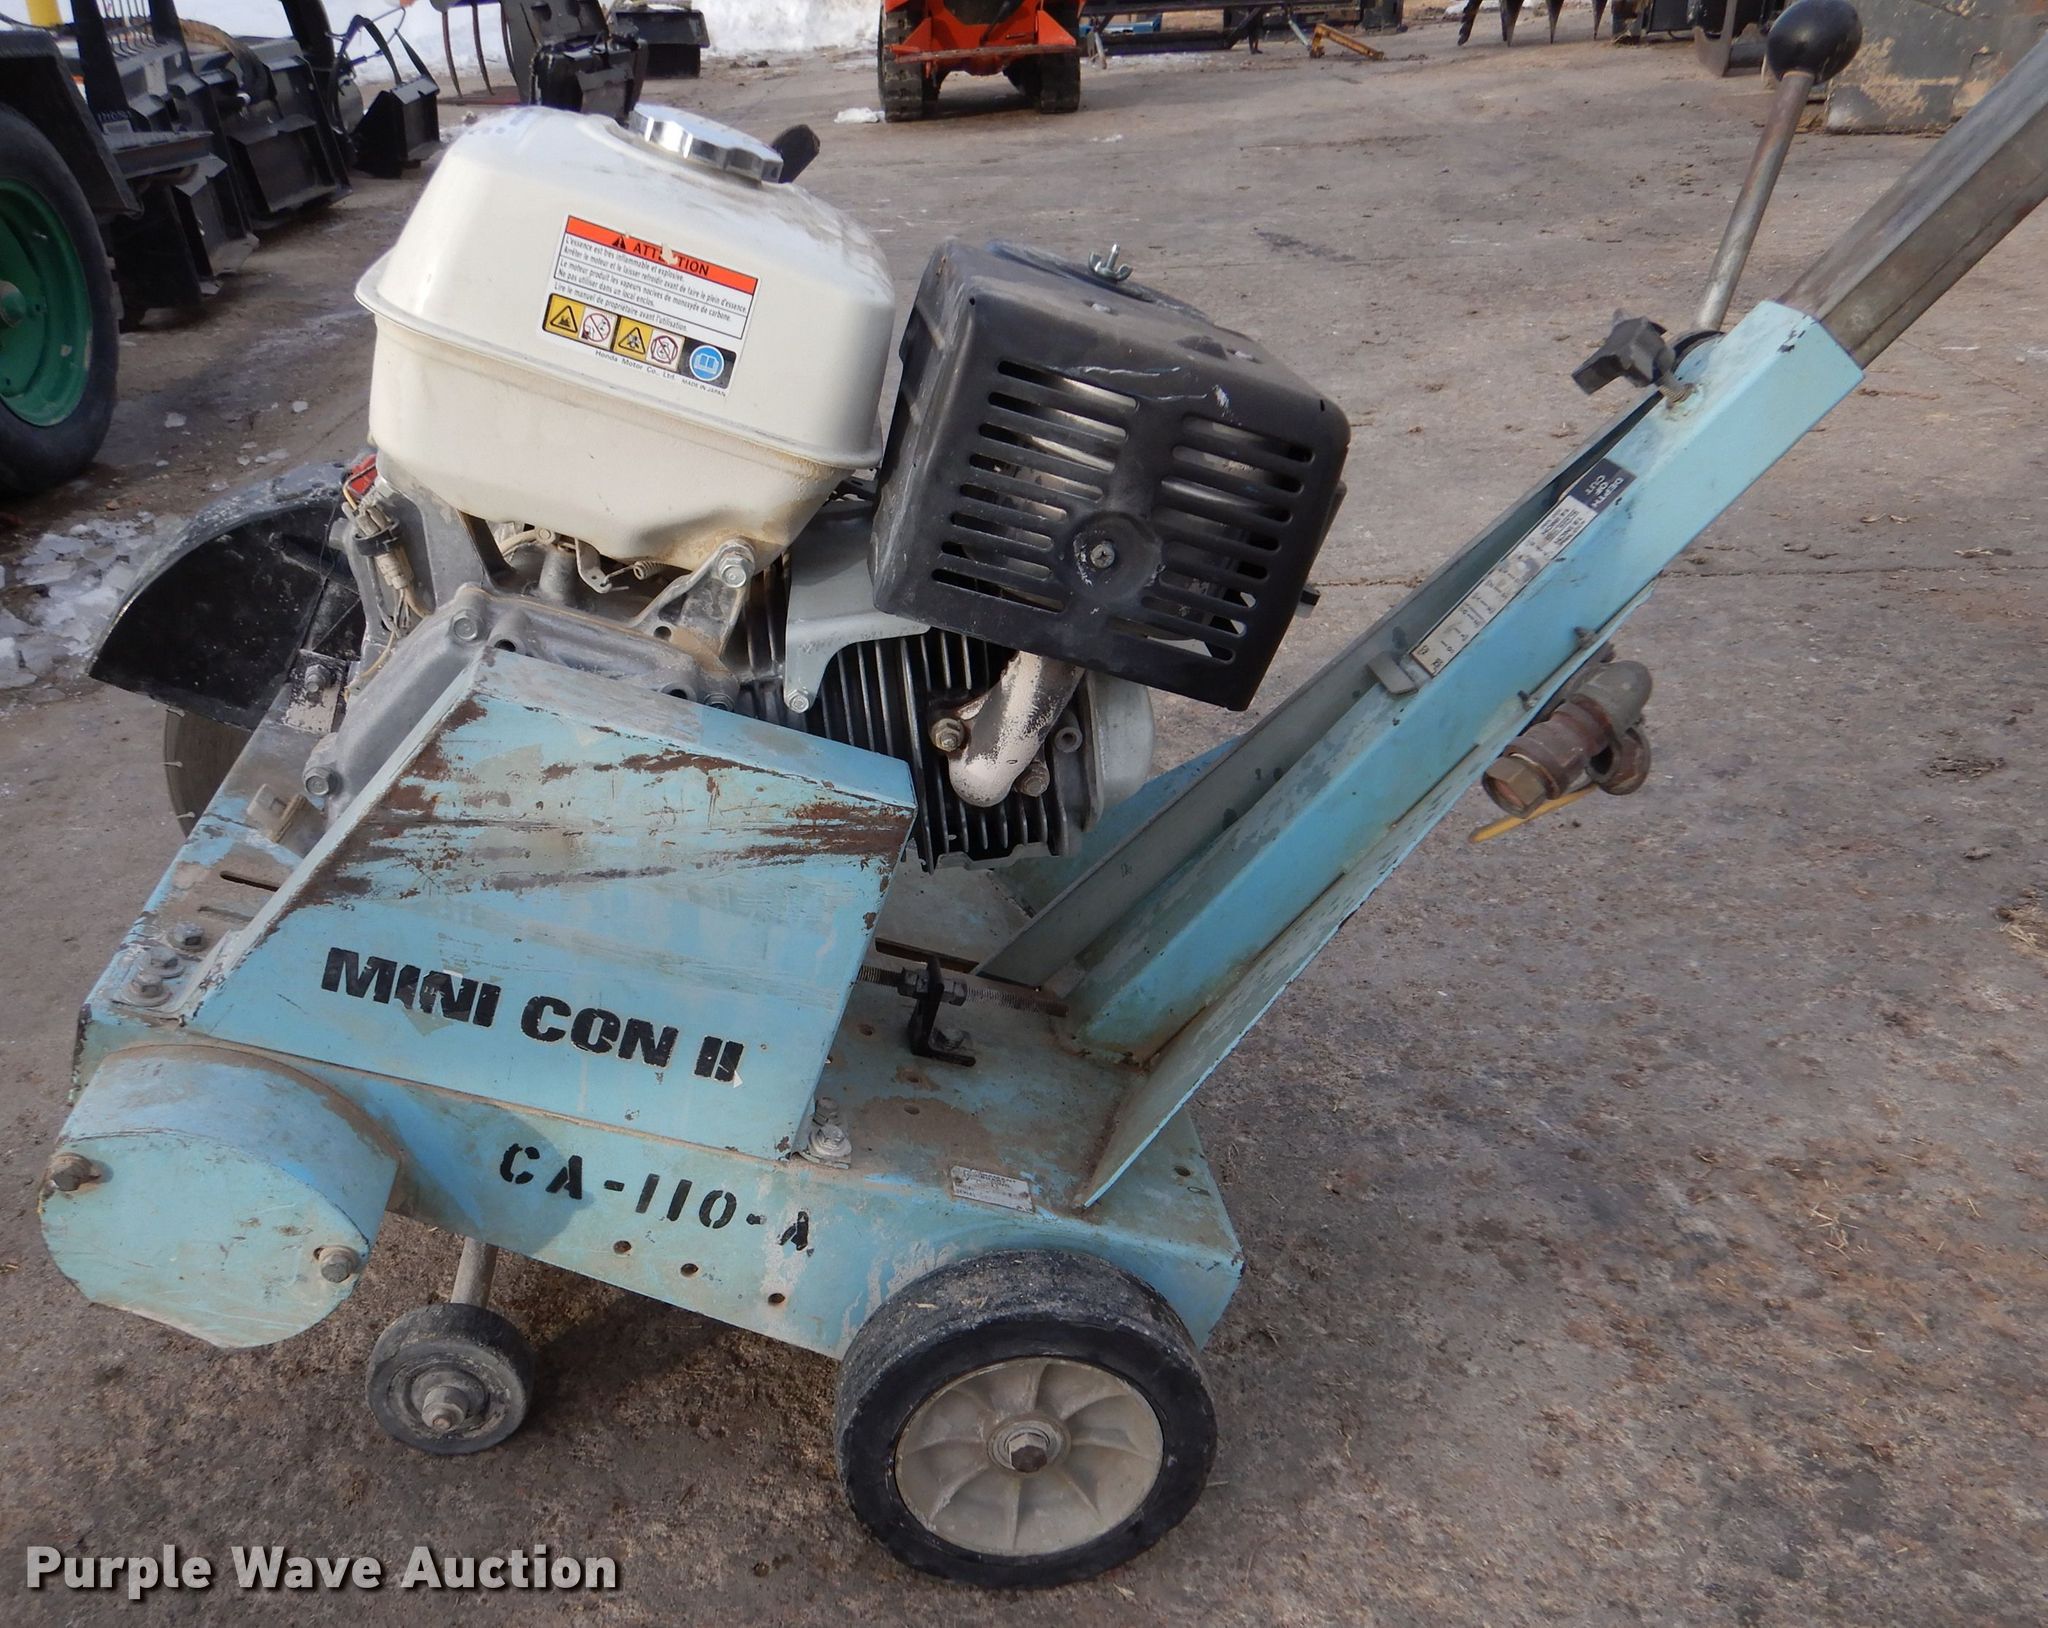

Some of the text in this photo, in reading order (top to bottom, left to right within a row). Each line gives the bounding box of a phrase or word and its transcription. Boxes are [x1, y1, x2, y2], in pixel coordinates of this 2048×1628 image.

[558, 268, 566, 277] Ne
[567, 273, 576, 281] pas
[578, 277, 597, 287] utiliser
[599, 282, 611, 292] dans
[622, 289, 635, 300] local
[560, 259, 566, 267] Le
[568, 264, 587, 274] moteur
[589, 271, 609, 281] produit
[610, 276, 618, 284] les
[620, 281, 641, 291] vapeurs
[642, 288, 662, 298] nocives
[664, 293, 670, 301] de
[700, 305, 707, 313] de
[583, 252, 588, 260] le
[590, 256, 608, 267] moteur
[616, 263, 621, 271] le
[622, 265, 639, 277] laisser
[664, 281, 678, 290] avant
[680, 284, 685, 292] de
[687, 287, 699, 297] faire
[700, 291, 705, 299] le
[706, 295, 719, 303] plein
[554, 282, 565, 291] Lire
[574, 290, 595, 301] manuel
[639, 311, 655, 320] avant
[595, 349, 618, 363] Honda
[621, 358, 643, 371] Motor
[682, 378, 698, 388] MADE
[707, 387, 726, 397] JAPAN
[1584, 475, 1605, 495] CUT
[1591, 477, 1624, 508] DEPTH
[1594, 482, 1608, 496] OF
[320, 947, 502, 1028] MINI
[520, 994, 680, 1069] CON
[500, 1142, 811, 1251] CA-110-A
